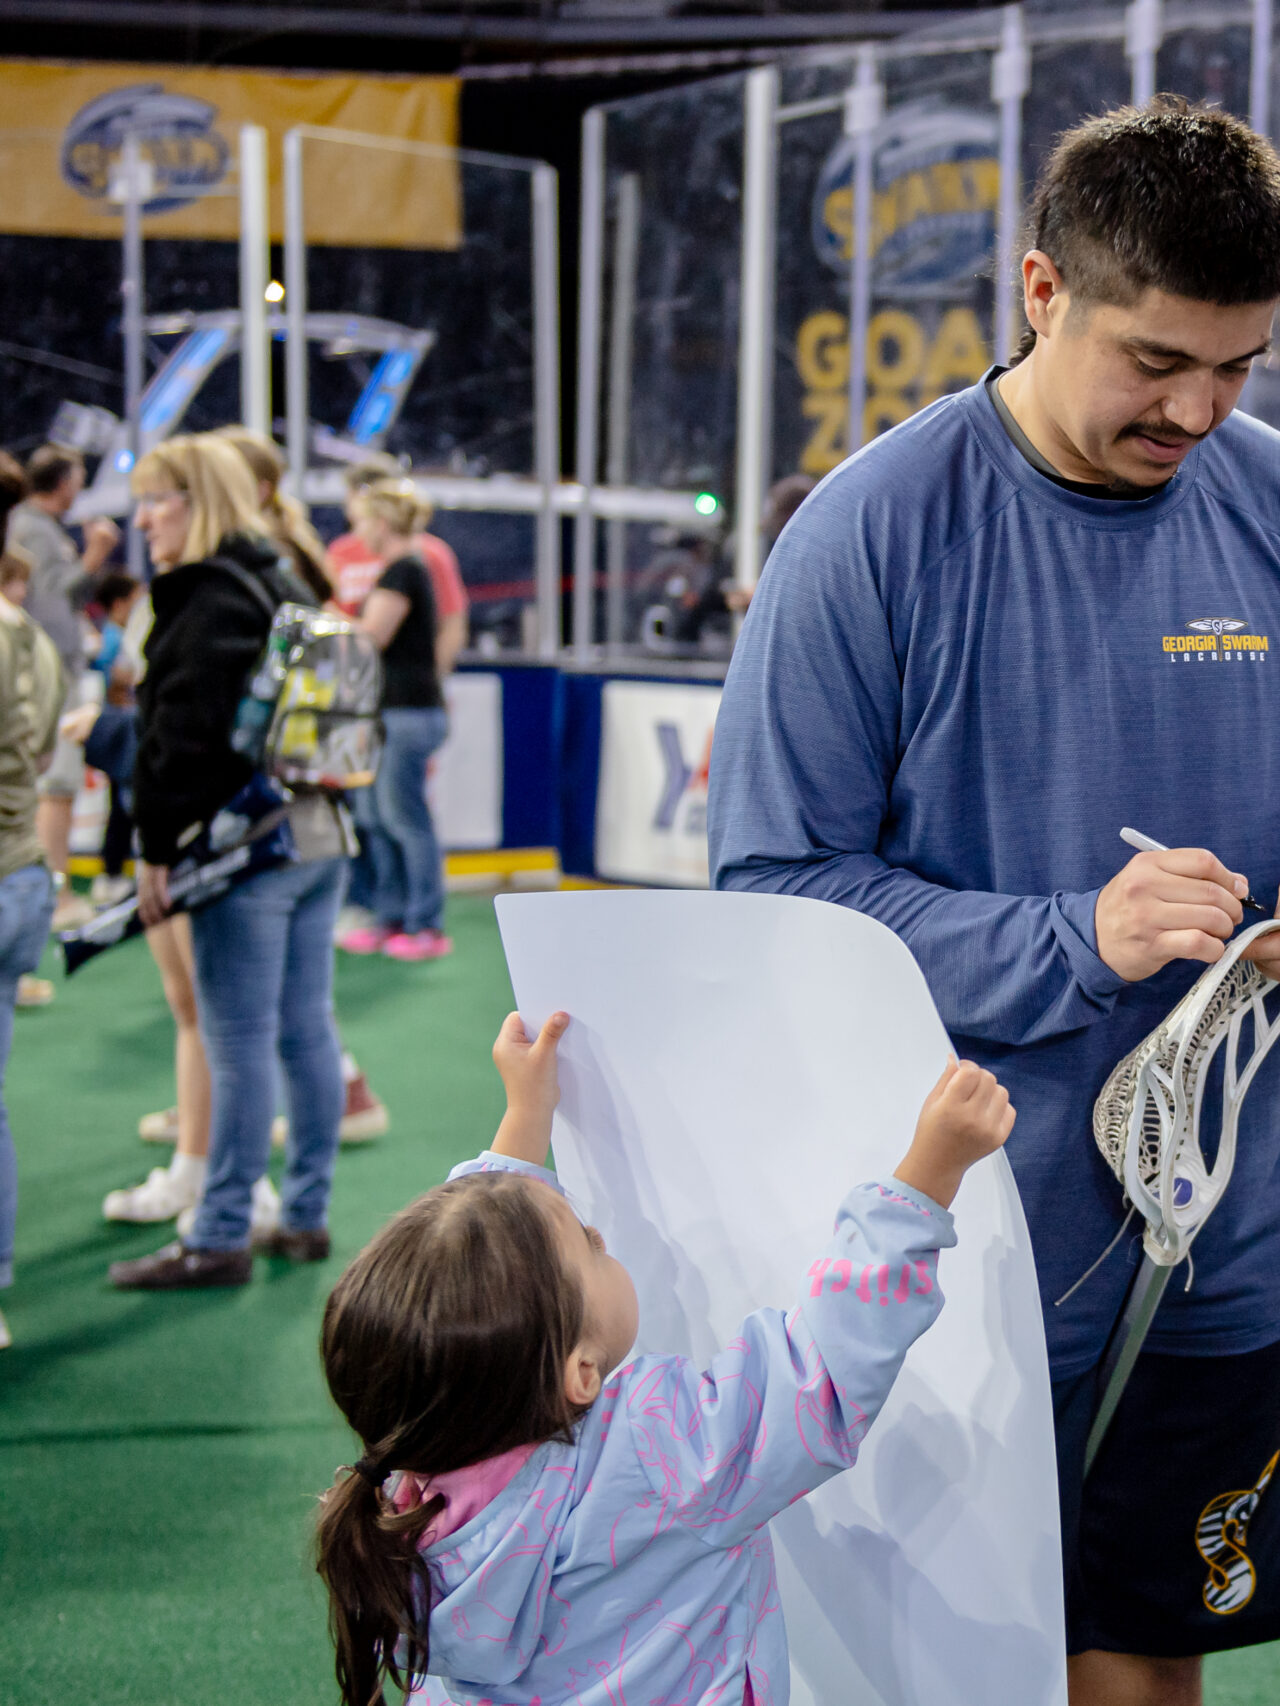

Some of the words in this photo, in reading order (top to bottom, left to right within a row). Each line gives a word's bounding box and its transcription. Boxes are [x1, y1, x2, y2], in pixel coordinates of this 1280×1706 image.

[1162, 635, 1217, 652] GEORGIA
[1222, 635, 1269, 651] SWARM
[1170, 652, 1265, 662] LACROSSE
[807, 1257, 934, 1307] stitch
